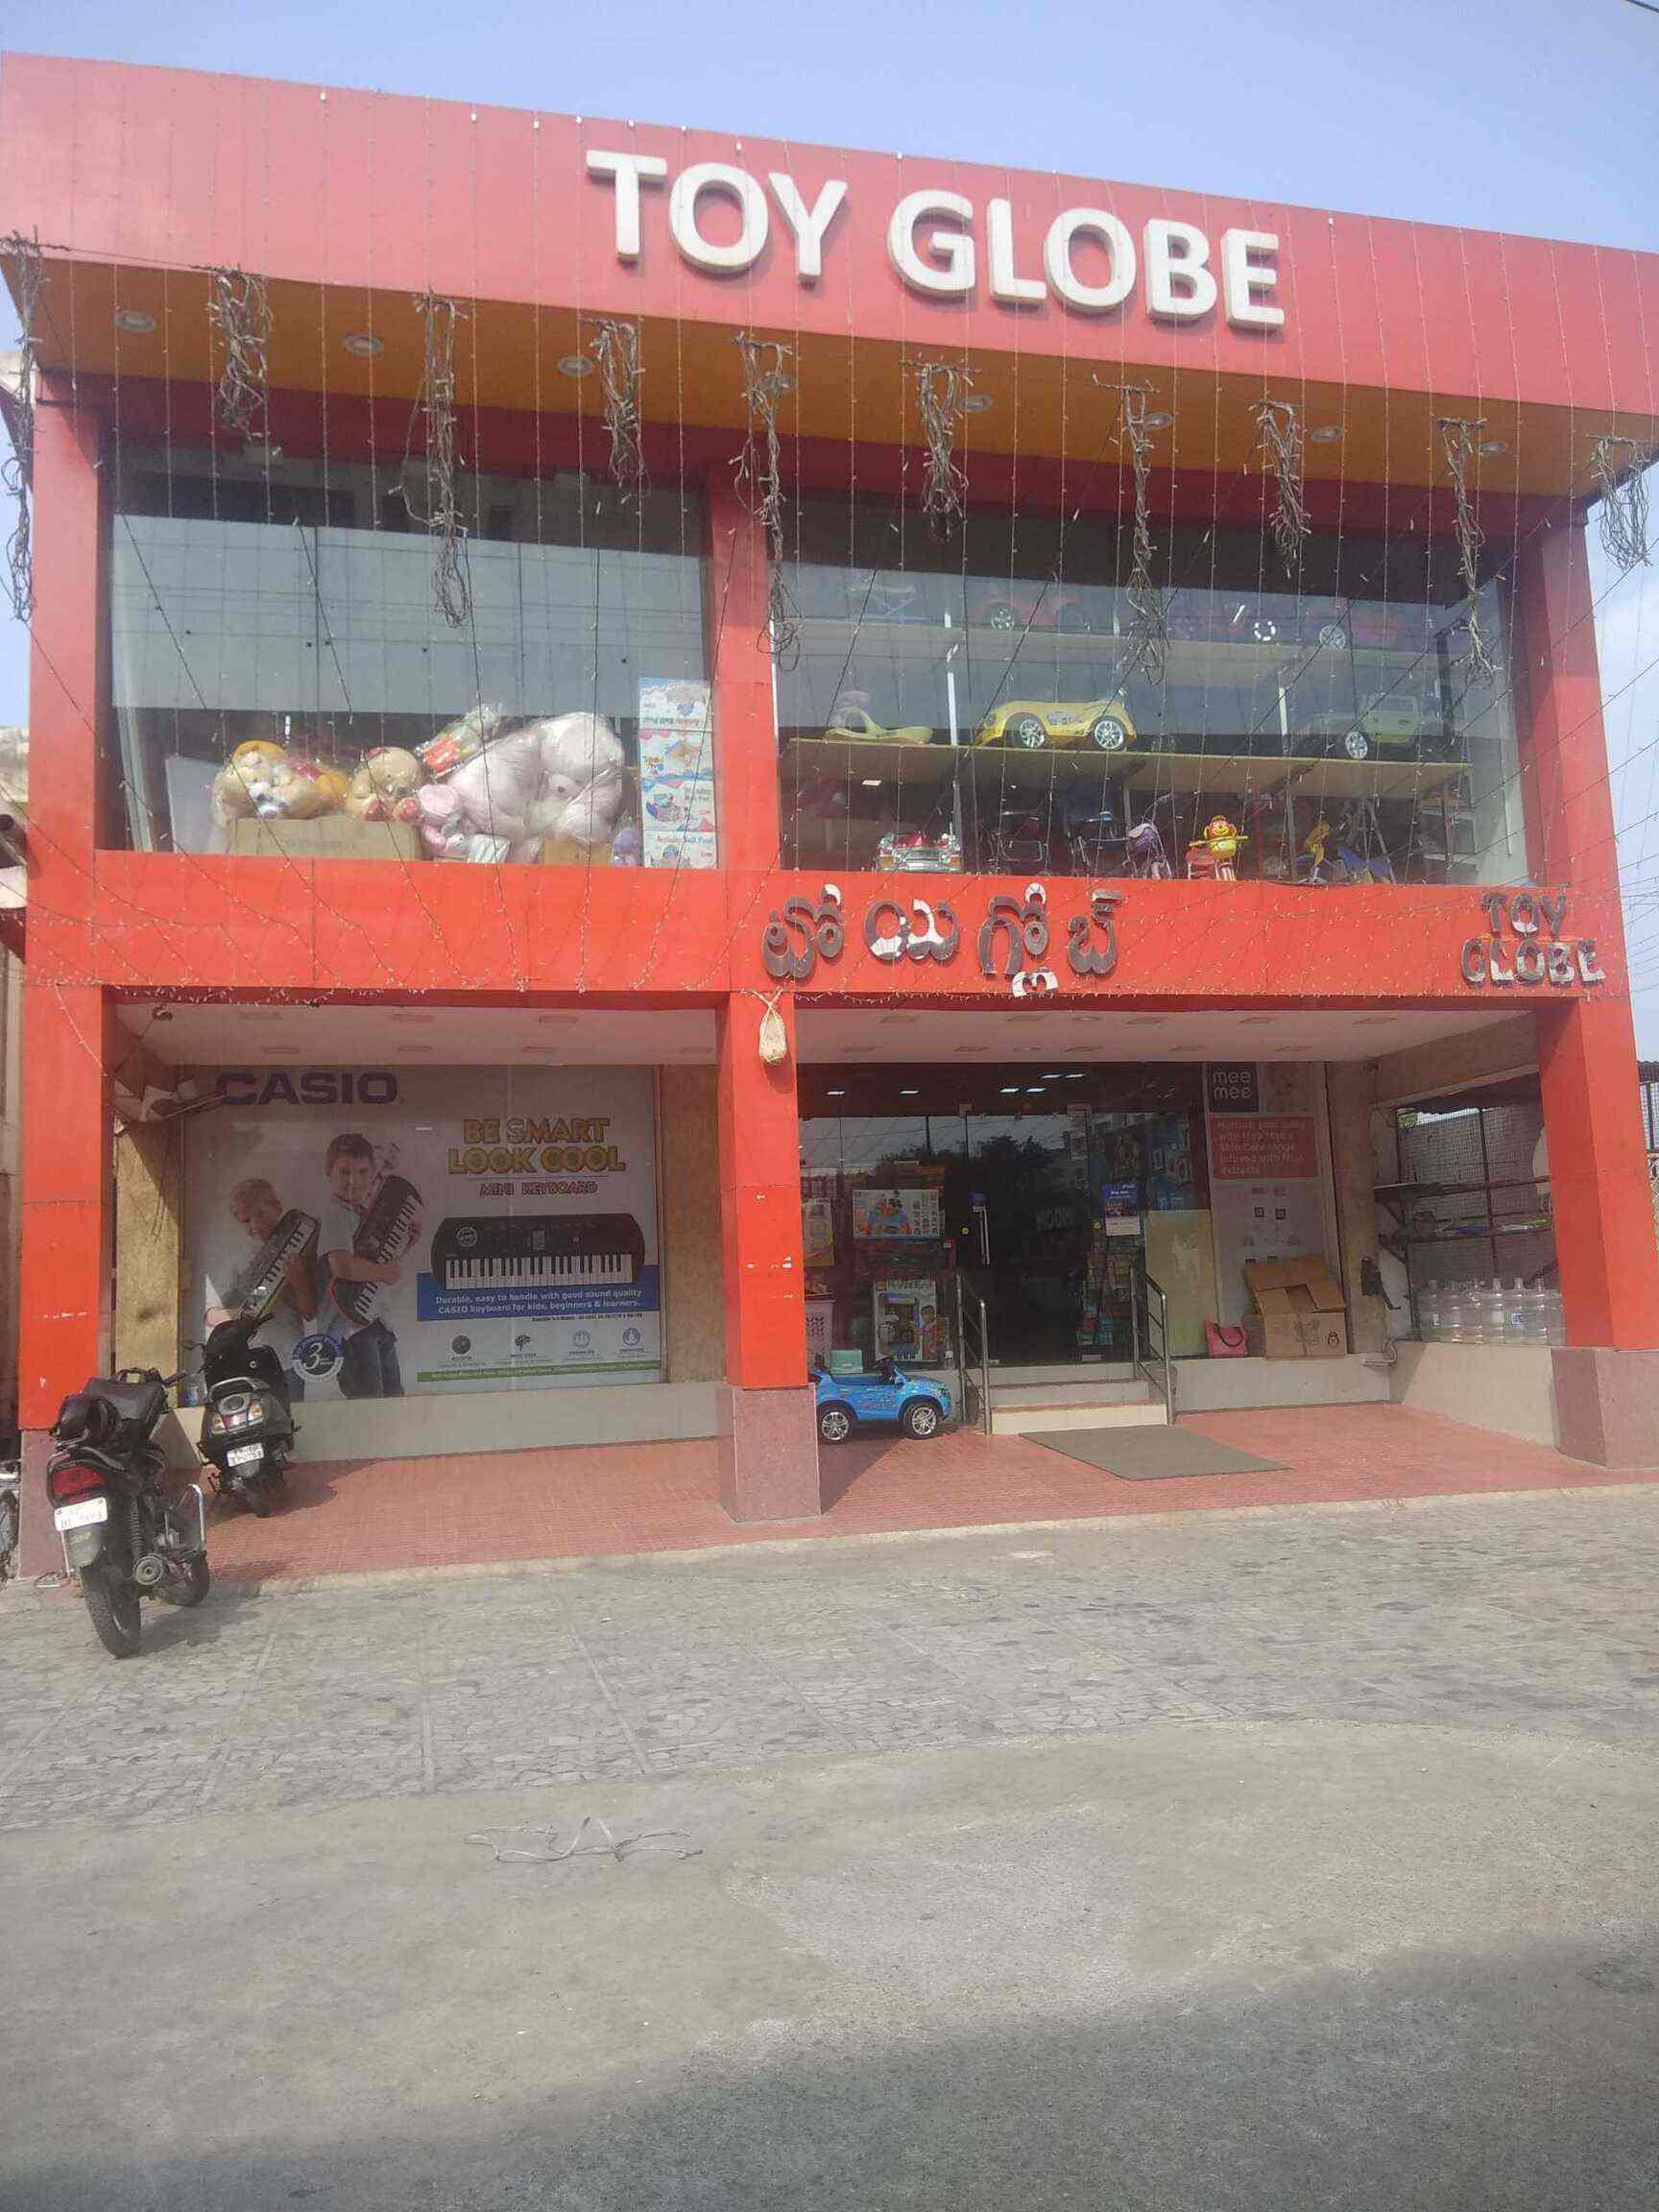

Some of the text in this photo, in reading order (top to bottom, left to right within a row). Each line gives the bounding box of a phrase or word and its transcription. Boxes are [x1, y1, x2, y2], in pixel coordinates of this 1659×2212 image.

[587, 150, 1286, 330] TOY GLOBE
[1482, 891, 1567, 938] TOY
[1460, 937, 1607, 985] GLOBE
[217, 1071, 398, 1105] CASIO
[1213, 1070, 1252, 1084] mee
[1214, 1086, 1253, 1099] mee
[463, 1117, 611, 1144] BE SMART
[446, 1144, 626, 1174] LOOK COOL
[480, 1180, 598, 1196] MINI KEYBOARD
[438, 1305, 469, 1315] CASIO
[470, 1304, 511, 1315] keyboard
[513, 1303, 526, 1312] for
[549, 1300, 593, 1311] beginners
[475, 1295, 495, 1305] easy
[497, 1293, 507, 1302] to
[541, 1290, 560, 1300] with
[562, 1290, 583, 1301] good
[586, 1289, 611, 1298] sound
[613, 1288, 642, 1299] quality
[304, 1342, 324, 1370] 3
